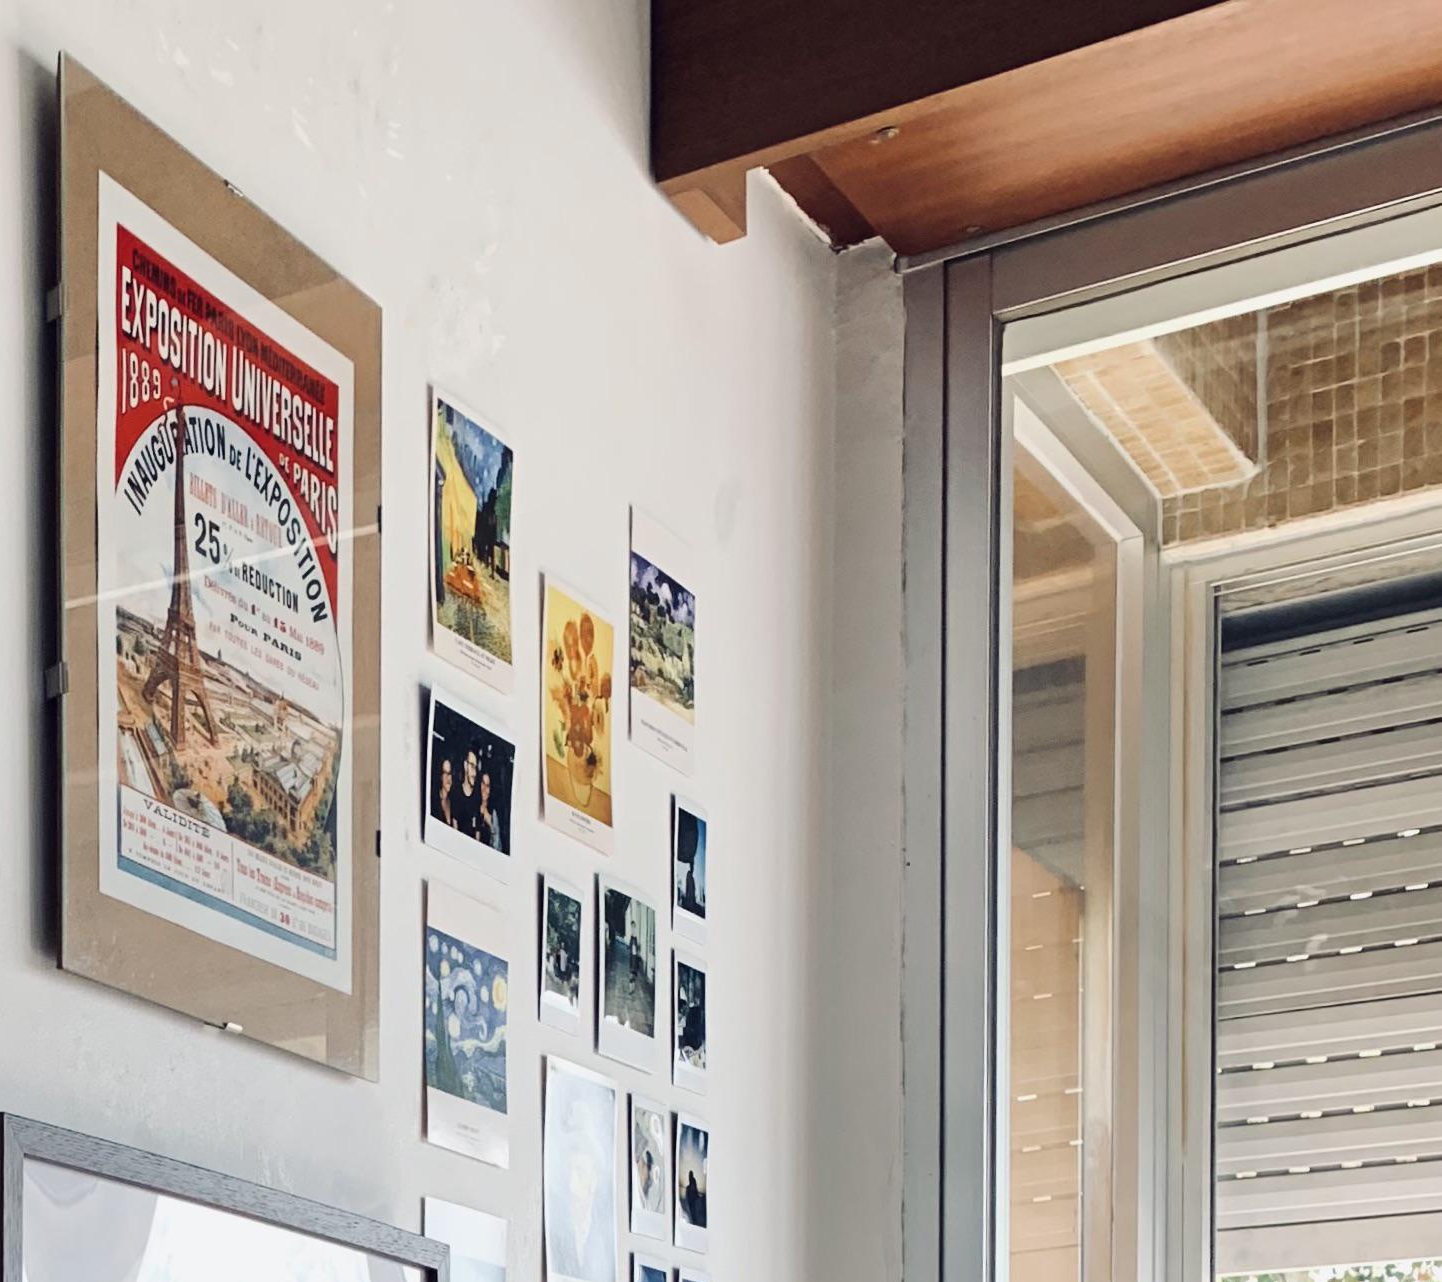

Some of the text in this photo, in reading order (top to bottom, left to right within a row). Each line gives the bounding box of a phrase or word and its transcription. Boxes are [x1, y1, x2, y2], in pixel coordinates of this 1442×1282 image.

[121, 265, 334, 473] EXPOSITION UNIVERSELLE
[122, 348, 161, 415] 1889
[229, 444, 242, 471] DE
[293, 464, 338, 555] PARIS
[262, 632, 302, 662] PARIS
